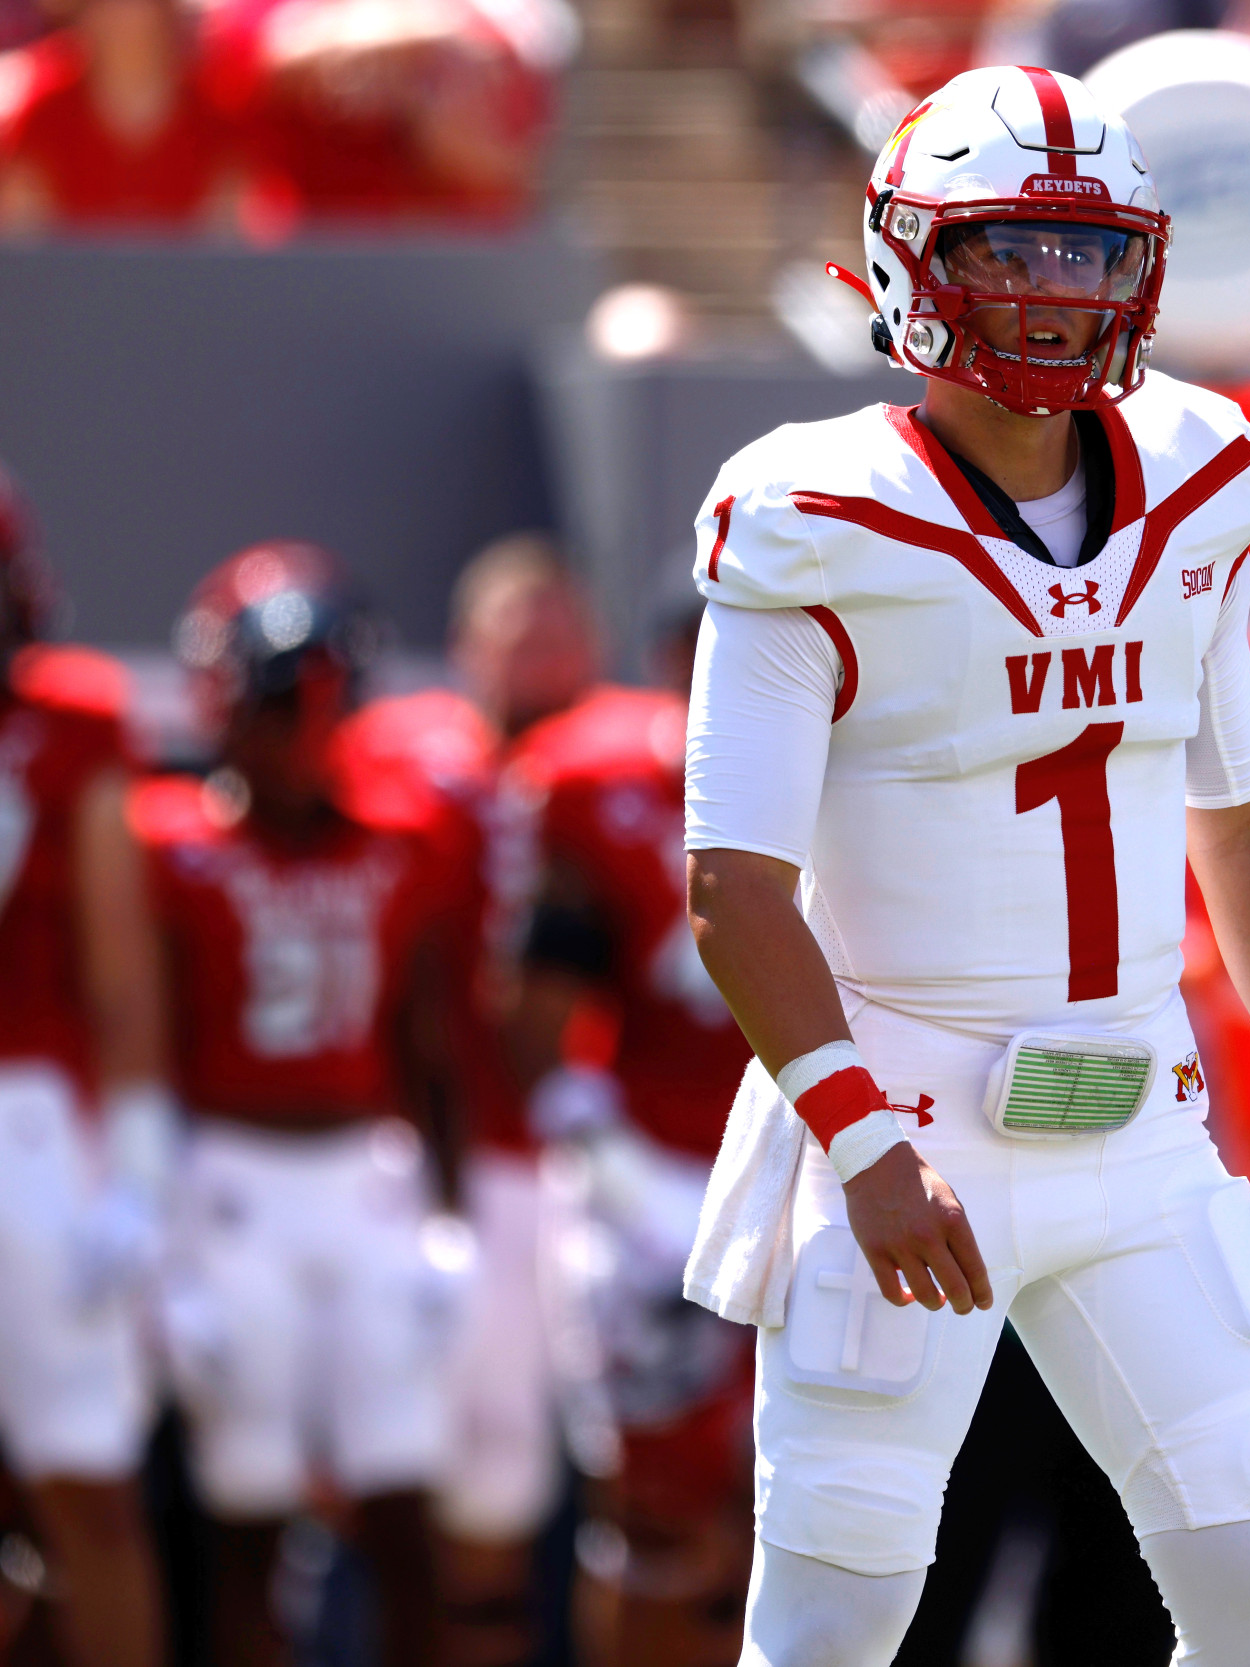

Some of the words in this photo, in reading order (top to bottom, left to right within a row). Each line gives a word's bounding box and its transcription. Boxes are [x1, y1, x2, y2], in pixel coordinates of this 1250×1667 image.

[1033, 179, 1102, 195] KEYDETS
[708, 494, 736, 583] 1
[1005, 640, 1144, 714] VMI
[1015, 721, 1124, 1004] 1
